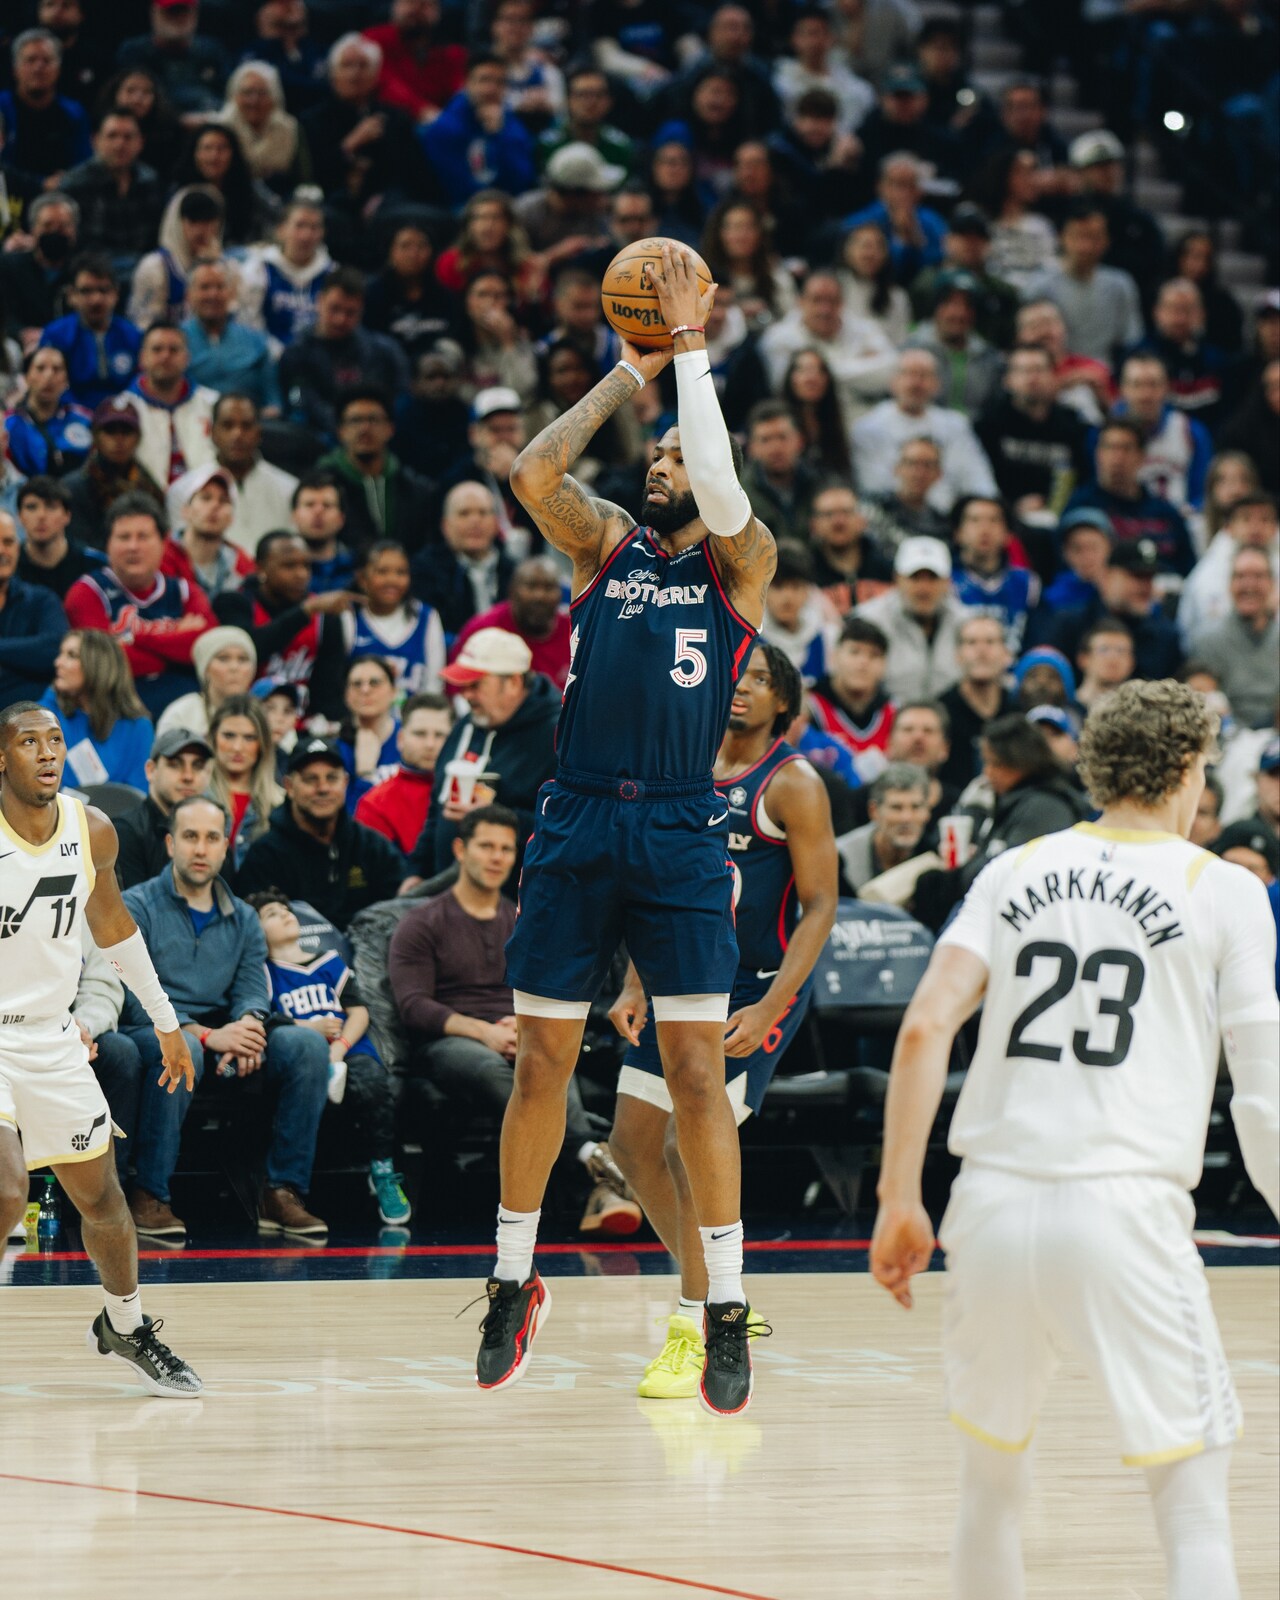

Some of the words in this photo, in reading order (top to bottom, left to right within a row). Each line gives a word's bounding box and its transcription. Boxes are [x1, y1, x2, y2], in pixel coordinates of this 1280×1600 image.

[605, 578, 709, 608] BROTHERLY
[617, 599, 645, 619] Love
[669, 628, 708, 688] 5
[51, 897, 77, 938] 11
[1000, 867, 1184, 948] MARKKANEN
[1006, 941, 1146, 1066] 23
